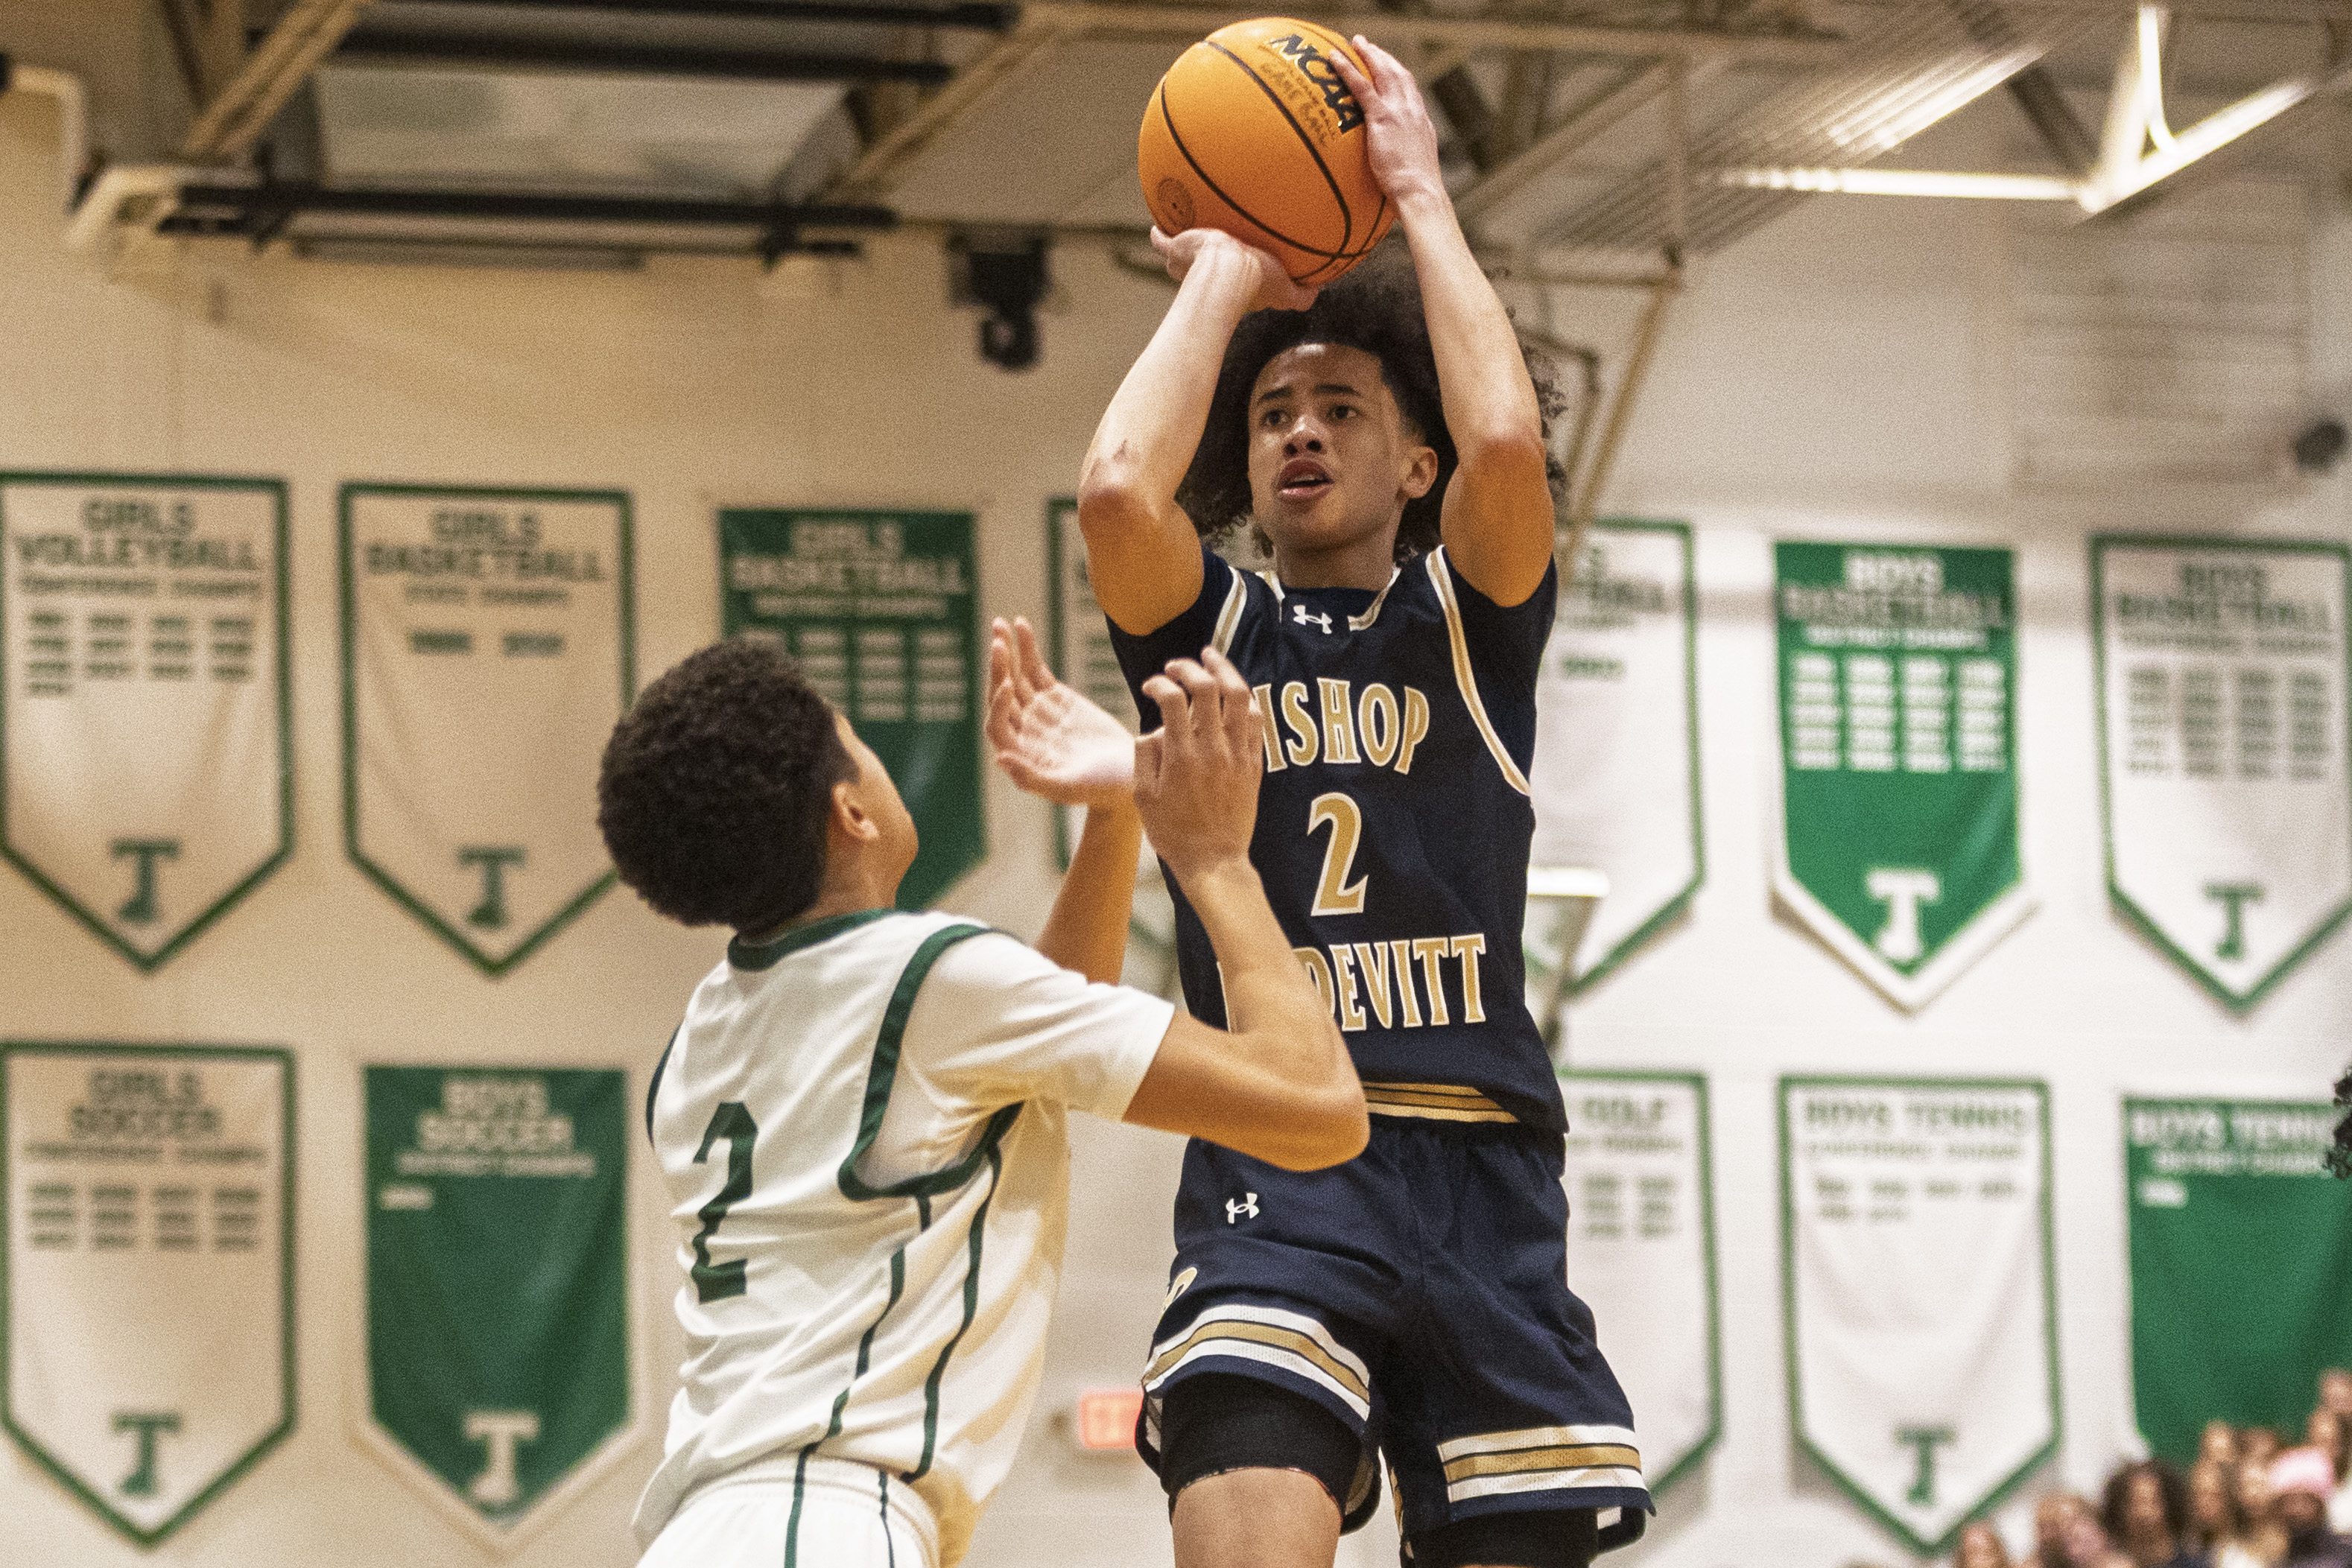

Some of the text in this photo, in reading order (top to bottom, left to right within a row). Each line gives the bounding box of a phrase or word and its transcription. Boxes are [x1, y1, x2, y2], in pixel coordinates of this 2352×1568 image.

[1269, 34, 1365, 134] NCAA
[84, 499, 195, 536] GIRLS
[432, 510, 541, 548] GIRLS
[15, 534, 259, 571] VOLLEYBALL
[367, 543, 603, 582] BASKETBALL
[1253, 676, 1430, 775] ISHOP
[1307, 791, 1369, 918] 2
[1291, 933, 1486, 1032] DEVITT
[89, 1070, 202, 1105] GIRLS
[69, 1104, 224, 1140] SOCCER
[2231, 1113, 2338, 1151] TENNI
[690, 1100, 758, 1305] 2
